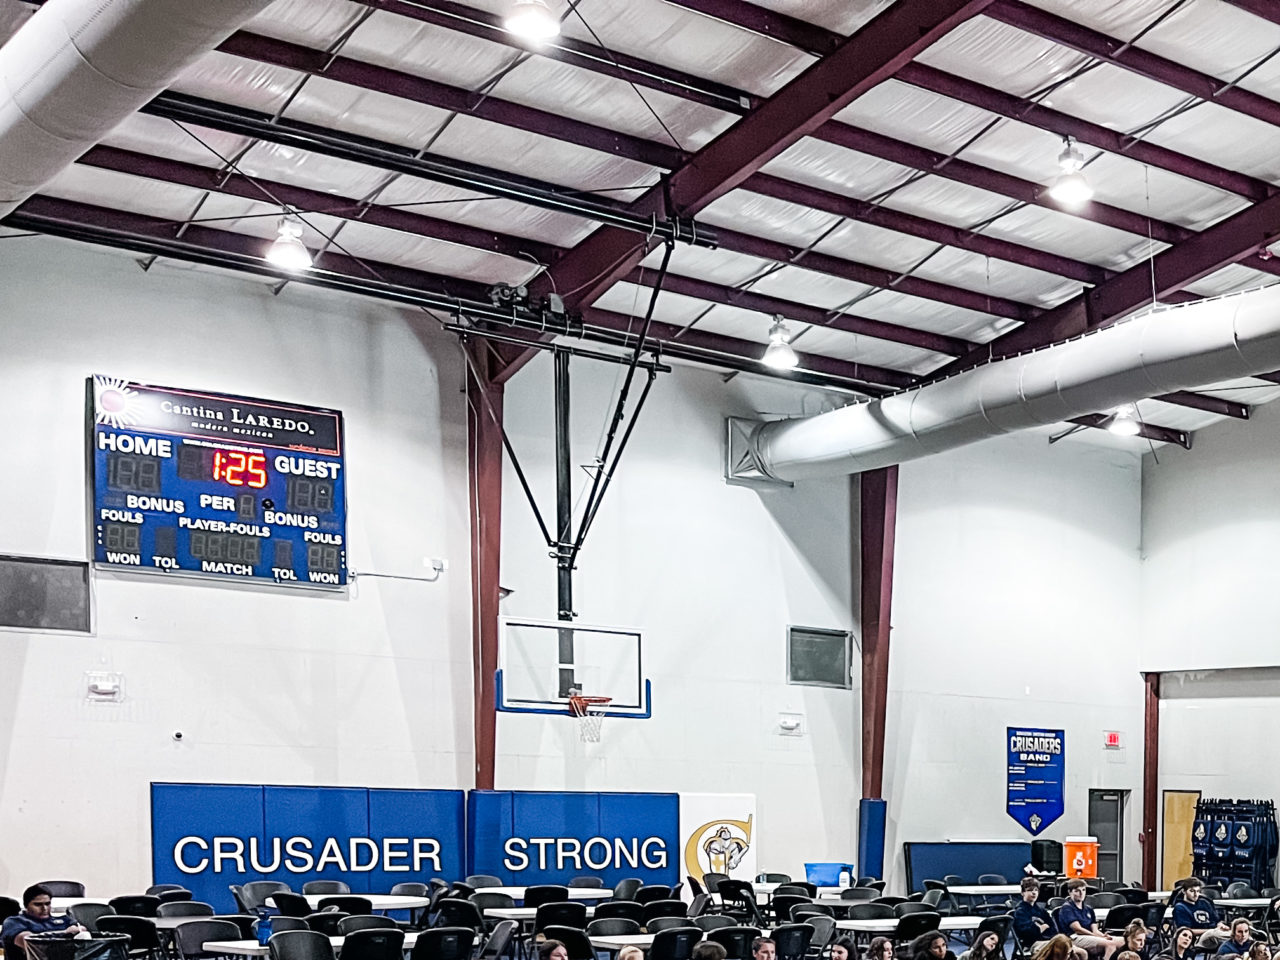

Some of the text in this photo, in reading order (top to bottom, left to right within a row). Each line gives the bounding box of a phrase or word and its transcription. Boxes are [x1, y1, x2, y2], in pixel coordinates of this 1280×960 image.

[161, 401, 224, 421] Cantina
[191, 421, 274, 439] modern mexican
[98, 433, 171, 458] HOME
[213, 449, 267, 488] 1:25
[274, 456, 341, 479] GUEST
[127, 494, 184, 514] BONUS
[200, 494, 235, 511] PER
[101, 509, 144, 524] FOULS
[264, 511, 318, 529] BONUS
[179, 517, 270, 537] PLAYER-FOULS
[304, 531, 342, 545] FOULS
[107, 552, 141, 565] WON
[152, 556, 180, 569] TOL
[202, 561, 252, 576] MATCH
[272, 568, 297, 581] TOL
[309, 571, 339, 584] WON
[1010, 736, 1061, 755] CRUSADERS
[1020, 753, 1051, 761] BAND
[173, 836, 667, 874] CRUSADER STRONG
